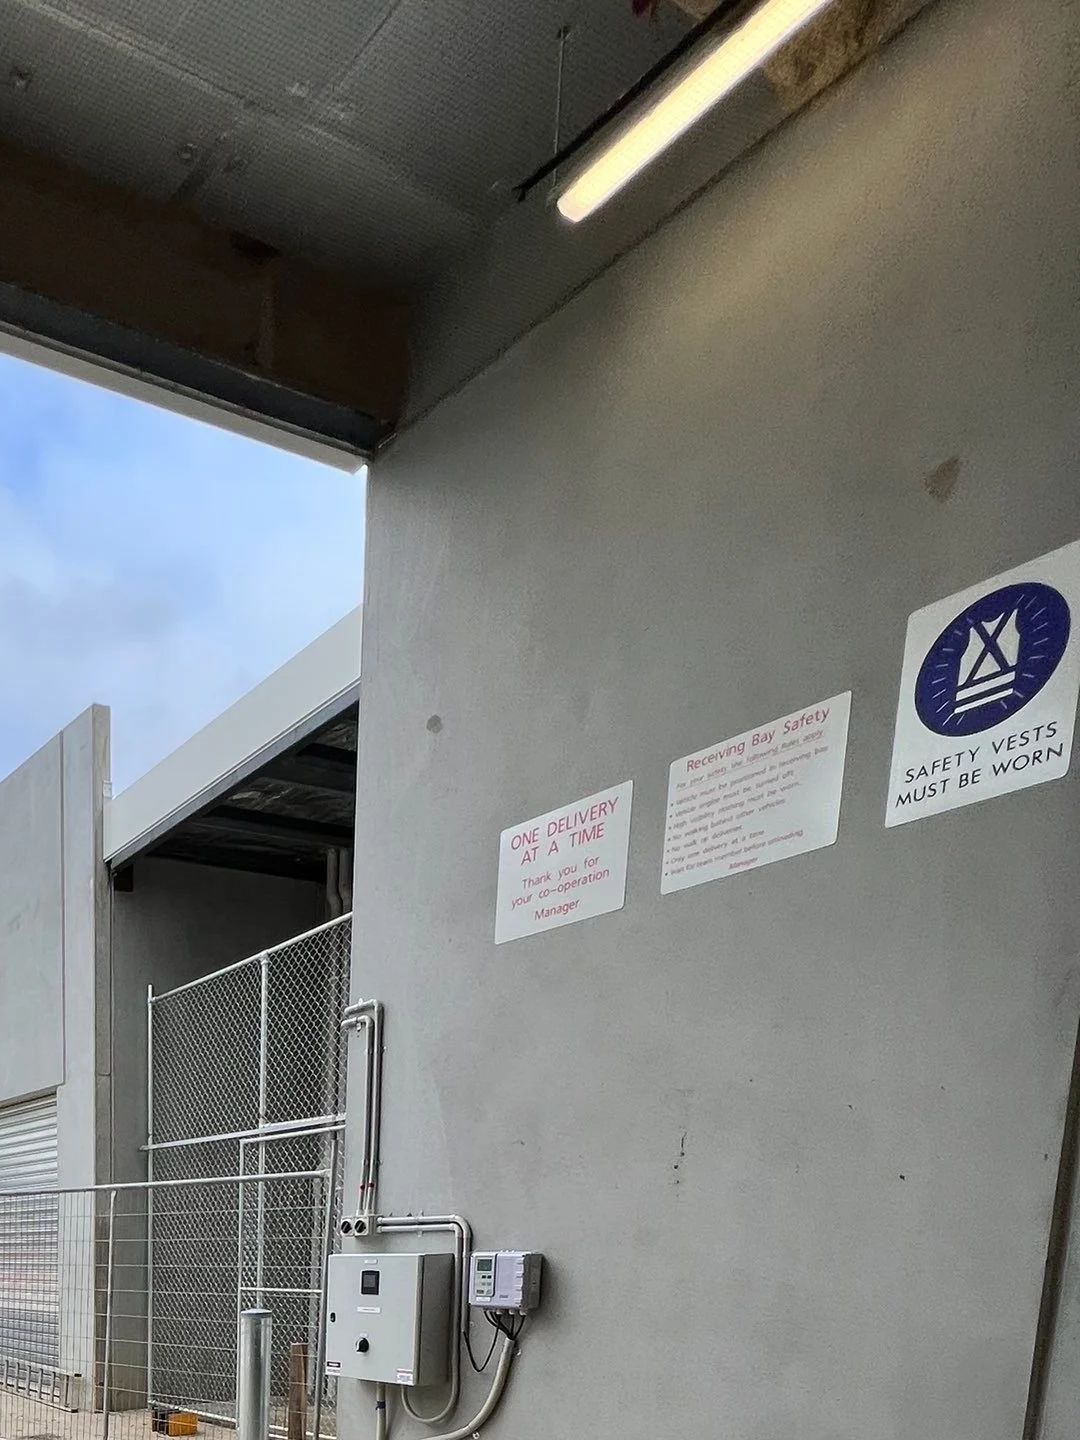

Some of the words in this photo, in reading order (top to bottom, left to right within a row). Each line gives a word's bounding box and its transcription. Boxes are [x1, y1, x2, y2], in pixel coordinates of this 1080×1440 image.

[686, 741, 746, 773] Receiving
[751, 730, 776, 747] Bay
[783, 707, 831, 735] Safety
[904, 746, 980, 784] SAFETY
[991, 721, 1058, 755] VESTS
[895, 778, 951, 808] MUST
[959, 768, 981, 789] BE
[992, 743, 1064, 777] WORN
[510, 826, 540, 850] ONE
[546, 796, 619, 837] DELIVERY
[520, 847, 540, 866] AT
[547, 840, 559, 856] A
[569, 822, 605, 848] TIME
[511, 893, 533, 911] your
[538, 868, 610, 900] co-operation
[521, 870, 552, 890] Thank
[557, 864, 578, 881] you
[583, 855, 600, 869] for
[533, 899, 580, 921] Manager
